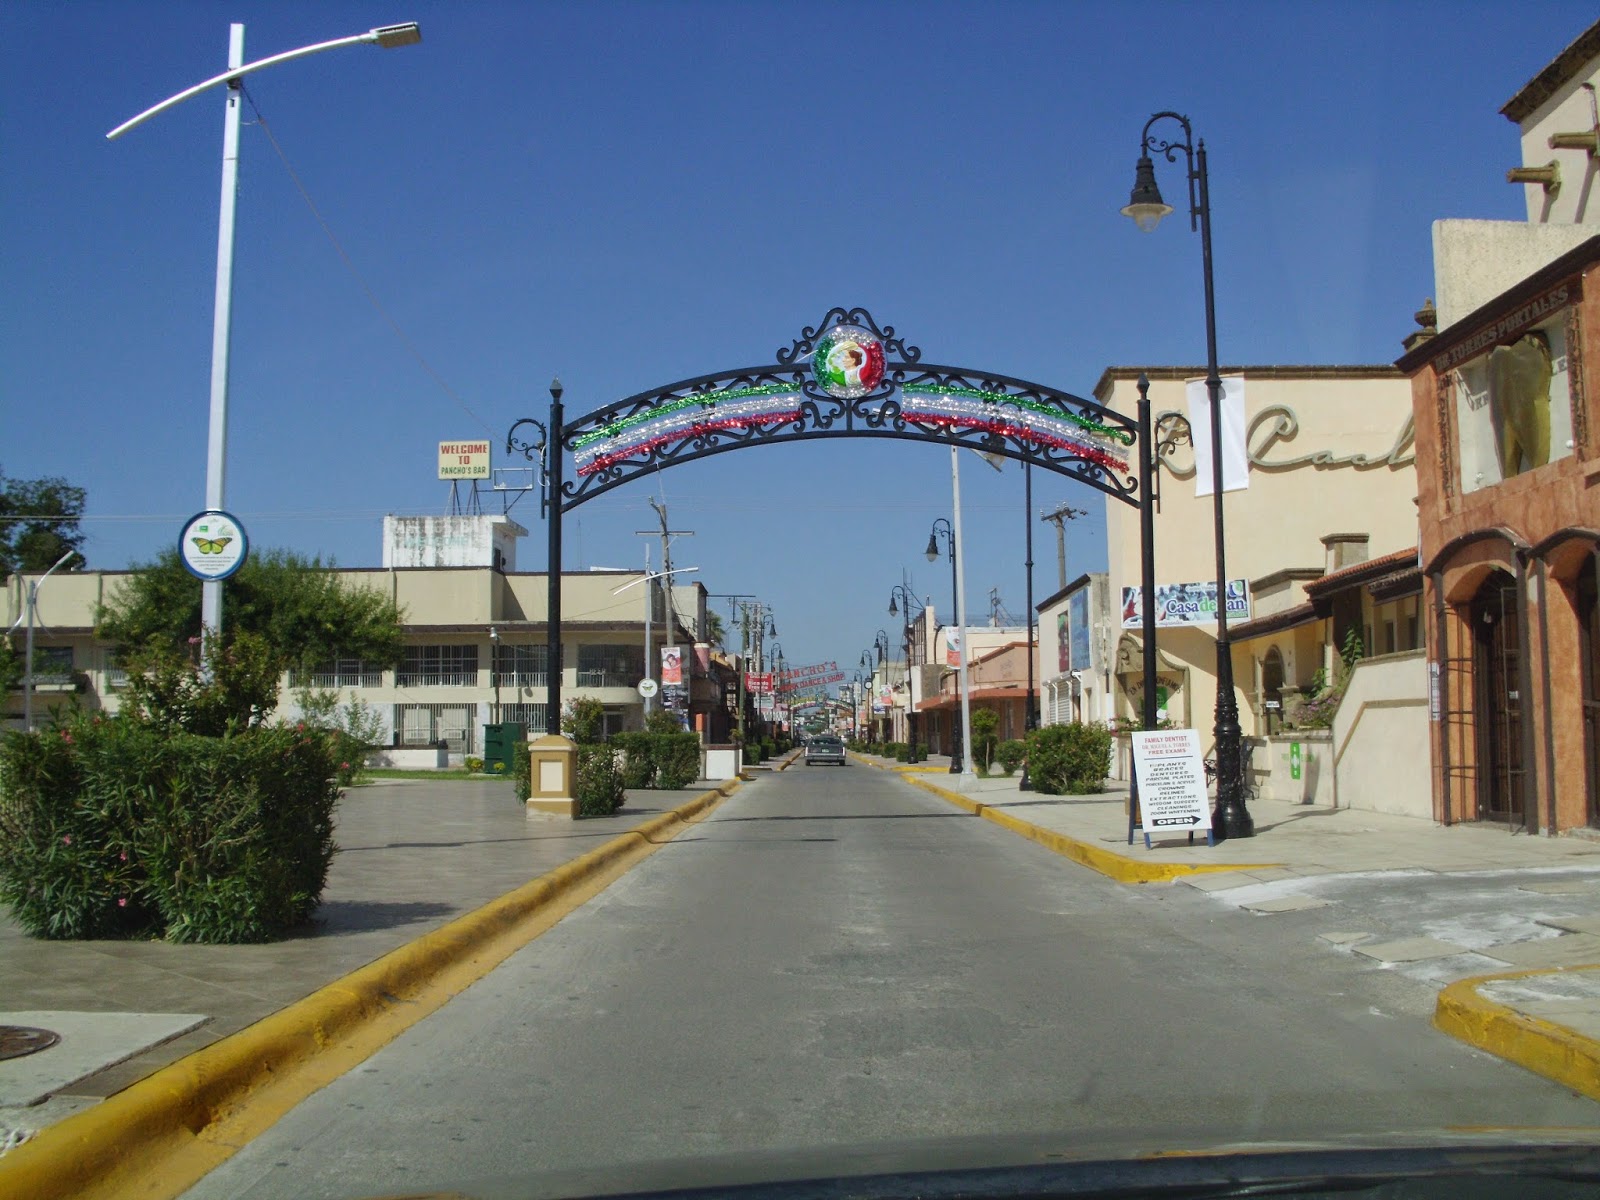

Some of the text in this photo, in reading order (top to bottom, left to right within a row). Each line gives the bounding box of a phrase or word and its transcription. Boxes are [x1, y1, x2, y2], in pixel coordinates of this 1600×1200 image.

[1452, 325, 1498, 362] TORRES
[441, 444, 487, 454] WELCOME
[458, 455, 470, 465] TO
[441, 466, 486, 475] PANCHO'S BAR
[1166, 599, 1199, 613] Casa
[779, 661, 837, 679] PANCHO'S
[827, 672, 844, 682] SHOP
[1157, 817, 1193, 825] OPEN
